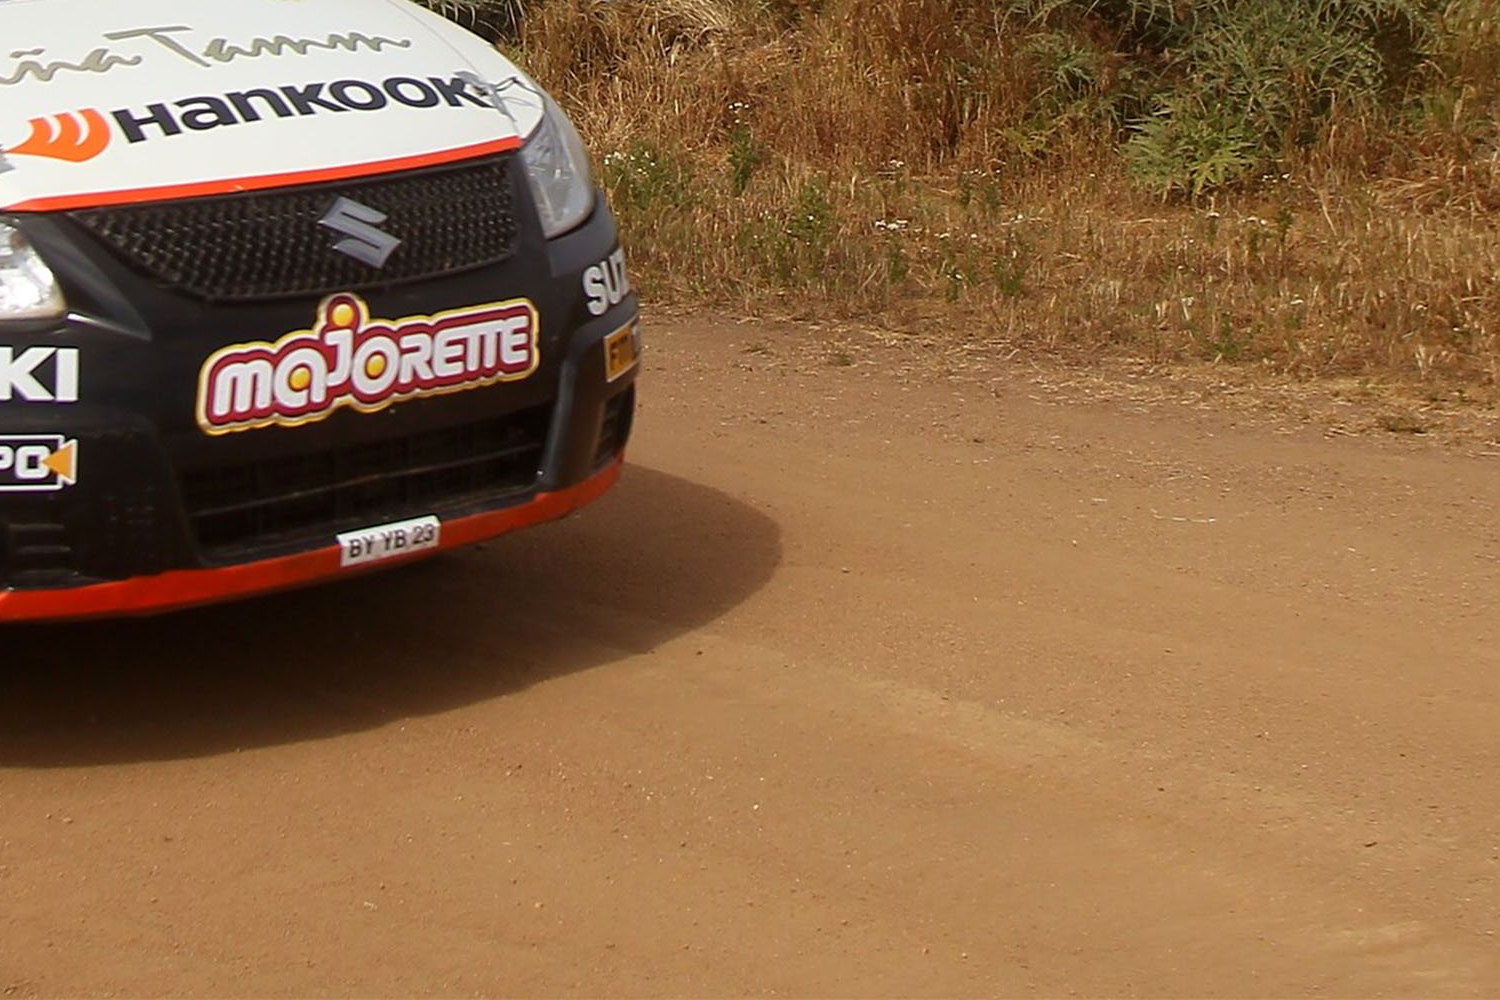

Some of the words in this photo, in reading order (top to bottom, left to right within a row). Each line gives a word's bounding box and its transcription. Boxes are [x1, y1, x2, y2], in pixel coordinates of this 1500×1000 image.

[103, 25, 411, 68] Tamm
[348, 534, 375, 558] BY
[380, 528, 407, 551] YB
[411, 522, 436, 546] 23
